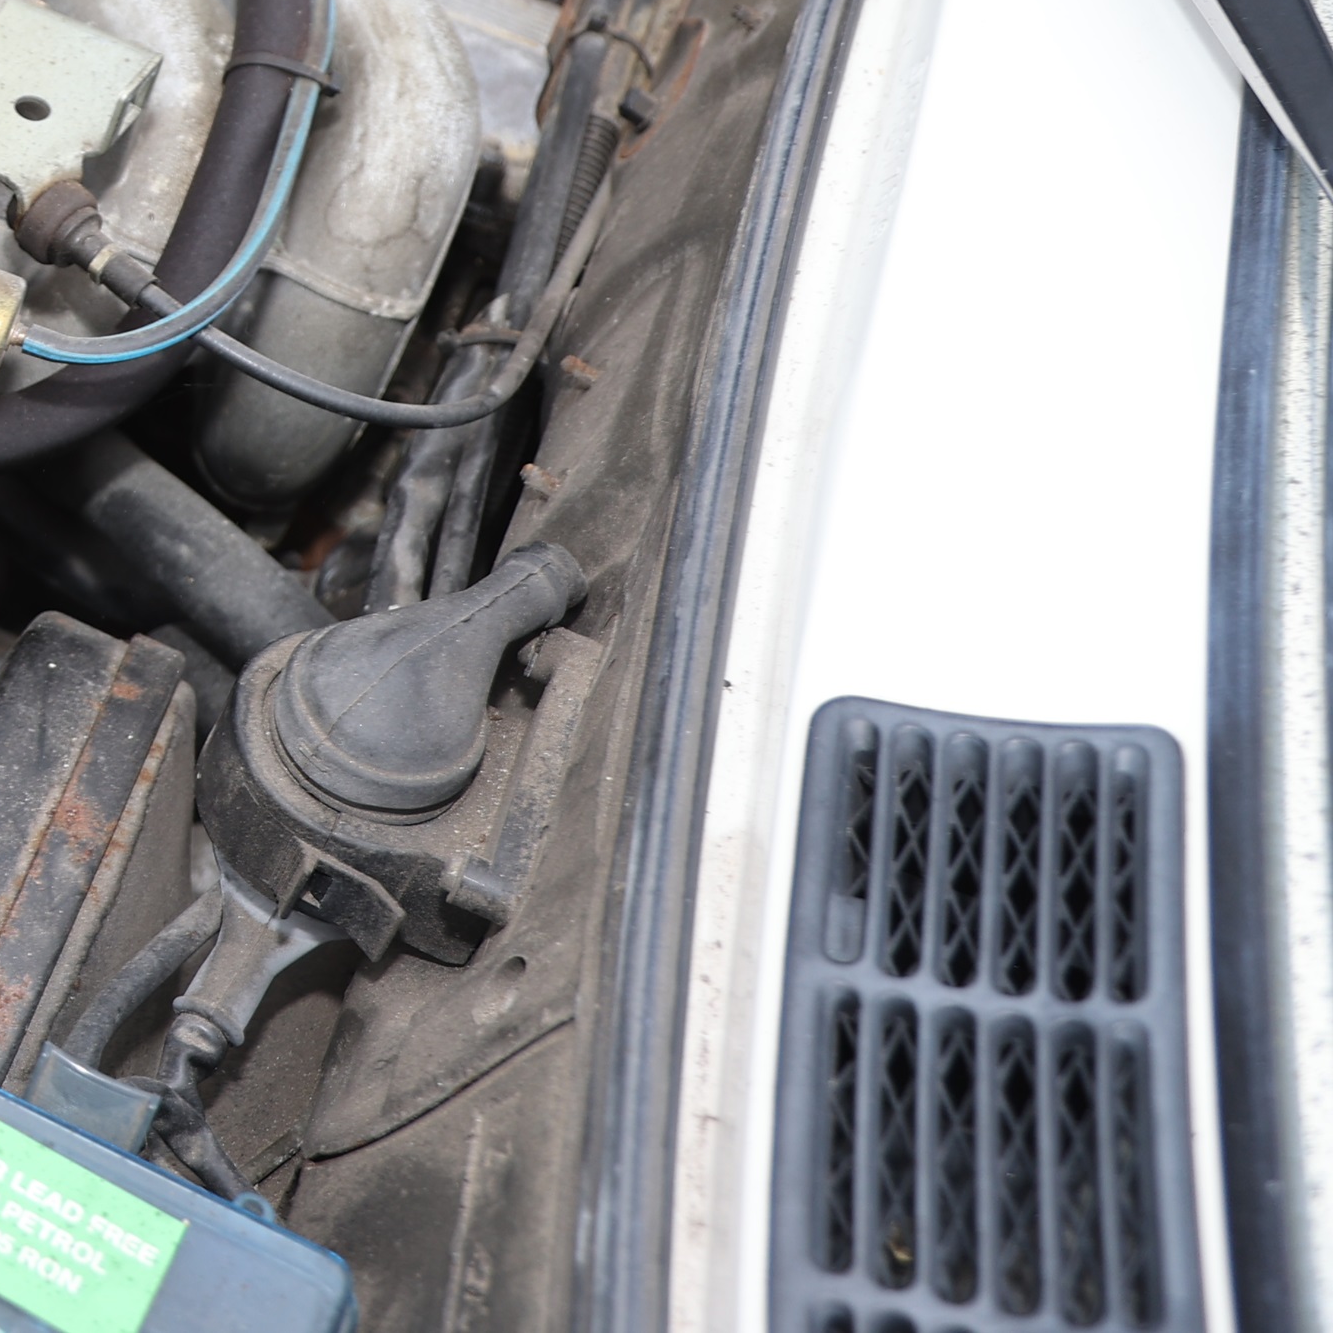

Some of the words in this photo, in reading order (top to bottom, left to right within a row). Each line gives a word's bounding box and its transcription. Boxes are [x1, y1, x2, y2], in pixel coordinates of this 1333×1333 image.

[8, 1170, 85, 1225] LEAD
[84, 1213, 160, 1267] FREE
[14, 1244, 84, 1295] RON
